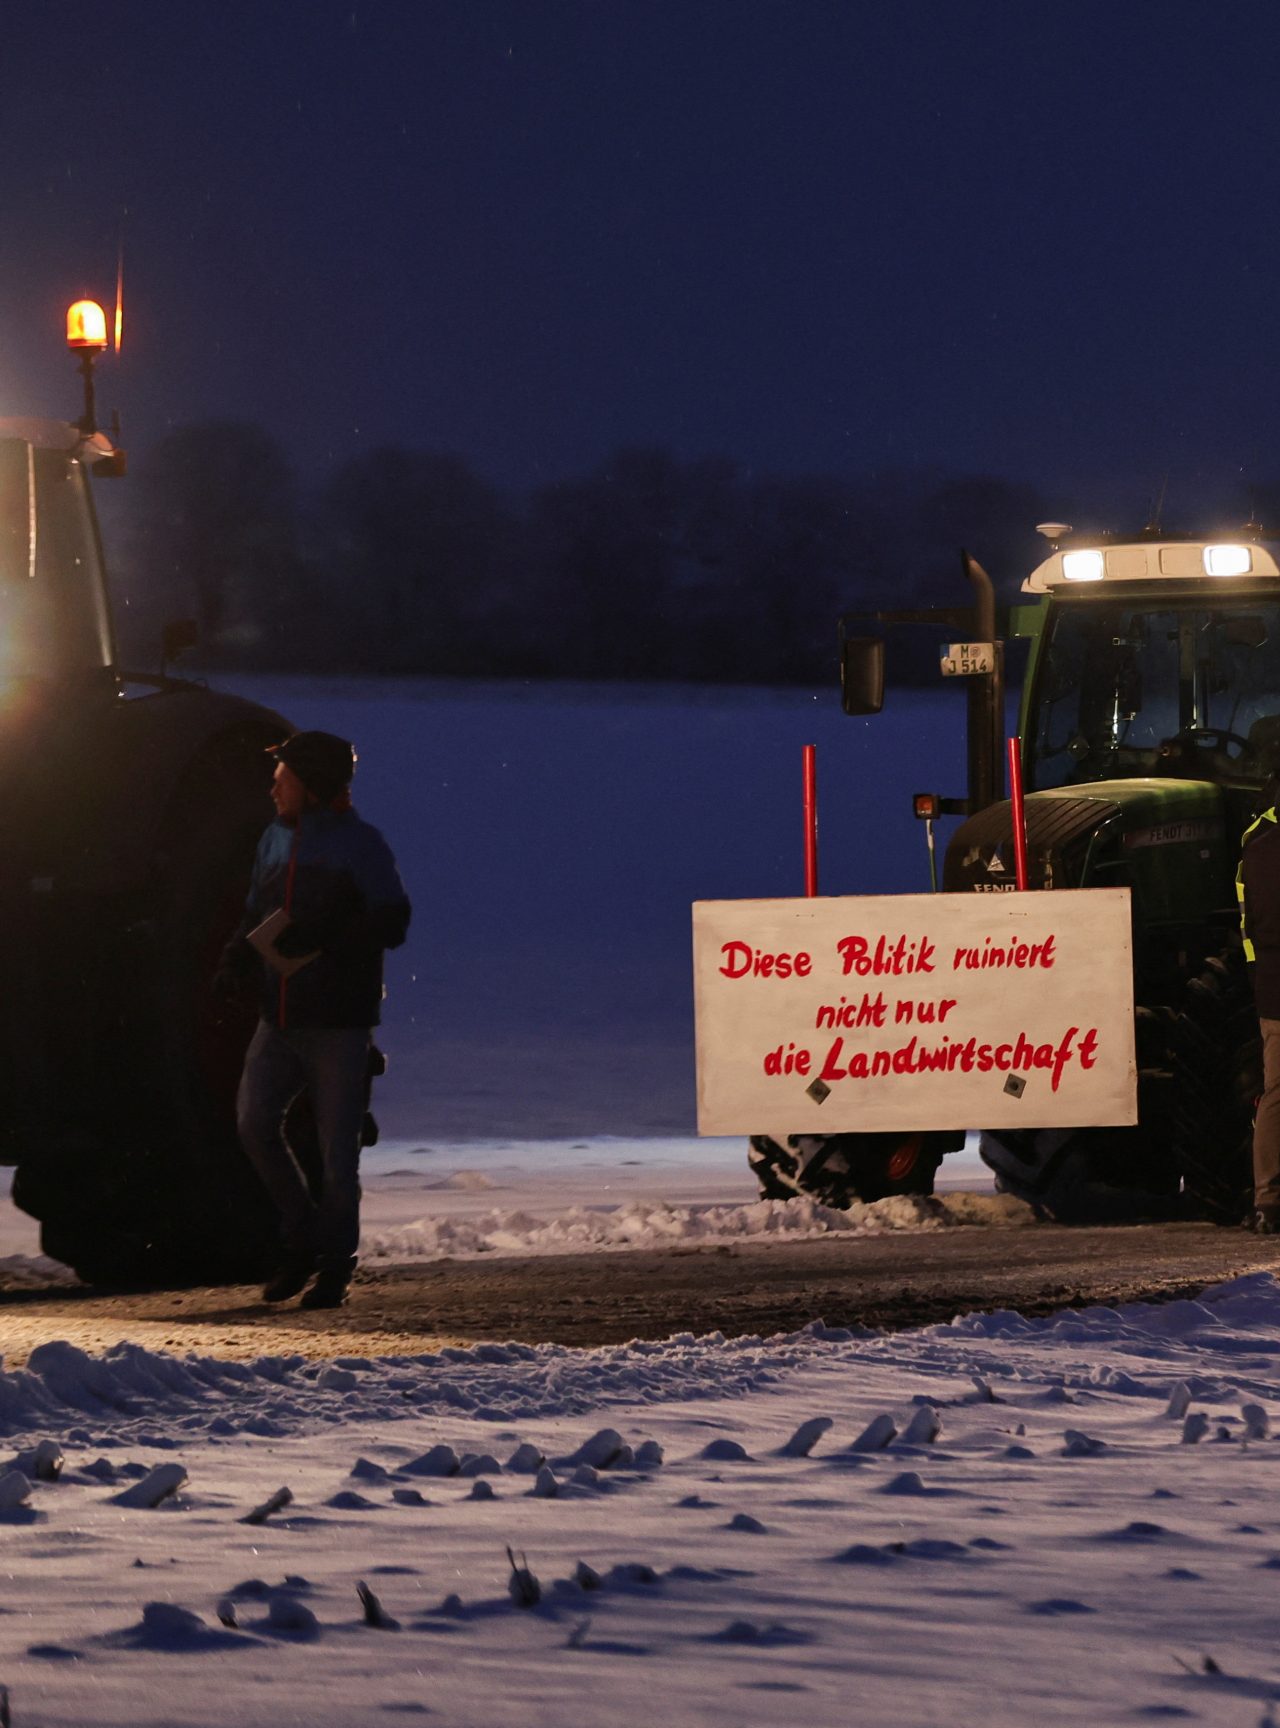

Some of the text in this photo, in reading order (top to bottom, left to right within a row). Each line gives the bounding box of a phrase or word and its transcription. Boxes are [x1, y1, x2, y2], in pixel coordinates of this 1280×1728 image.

[960, 645, 969, 659] M
[948, 659, 987, 674] J 514
[1150, 824, 1183, 841] FENDT
[973, 883, 1016, 893] FEND
[719, 934, 1057, 979] Diese Politik ruiniert
[815, 991, 957, 1029] nicht nur
[763, 1026, 1099, 1093] die Landwirtschaft
